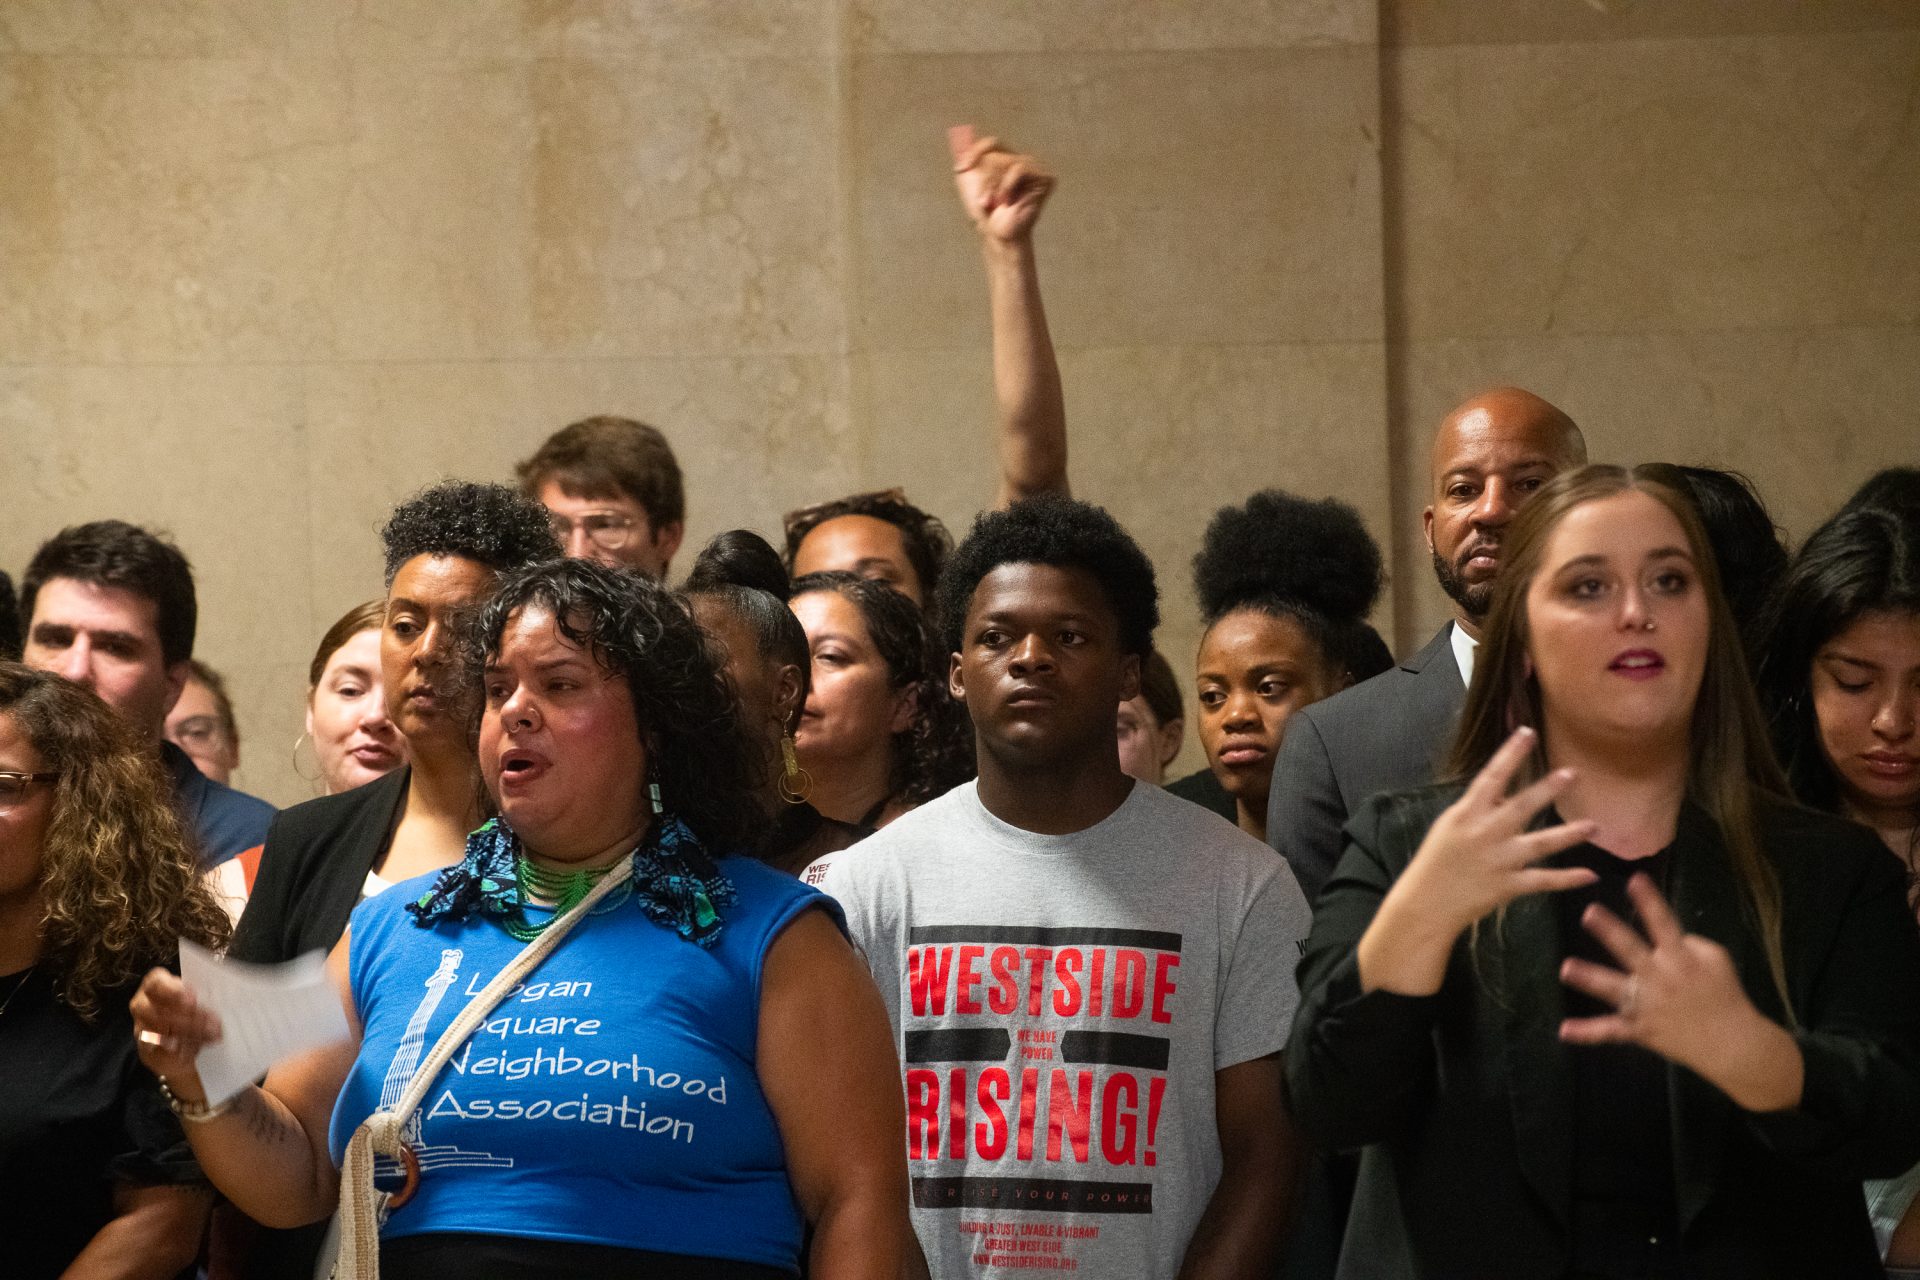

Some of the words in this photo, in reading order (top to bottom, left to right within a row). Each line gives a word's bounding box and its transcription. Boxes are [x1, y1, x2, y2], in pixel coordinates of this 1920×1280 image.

[907, 946, 1180, 1024] WESTSIDE
[1017, 1029, 1030, 1041] WE
[1033, 1030, 1056, 1042] HAVE
[1021, 1046, 1053, 1060] POWER
[450, 1042, 727, 1104] Neighborhood
[427, 1089, 695, 1143] Association
[906, 1067, 1167, 1167] RISING!
[1016, 1188, 1069, 1200] YOUR
[1087, 1192, 1150, 1203] POWER
[989, 1223, 995, 1233] A
[1064, 1226, 1100, 1239] VIBRANT
[984, 1238, 1016, 1251] GREATER
[1019, 1240, 1040, 1252] WEST
